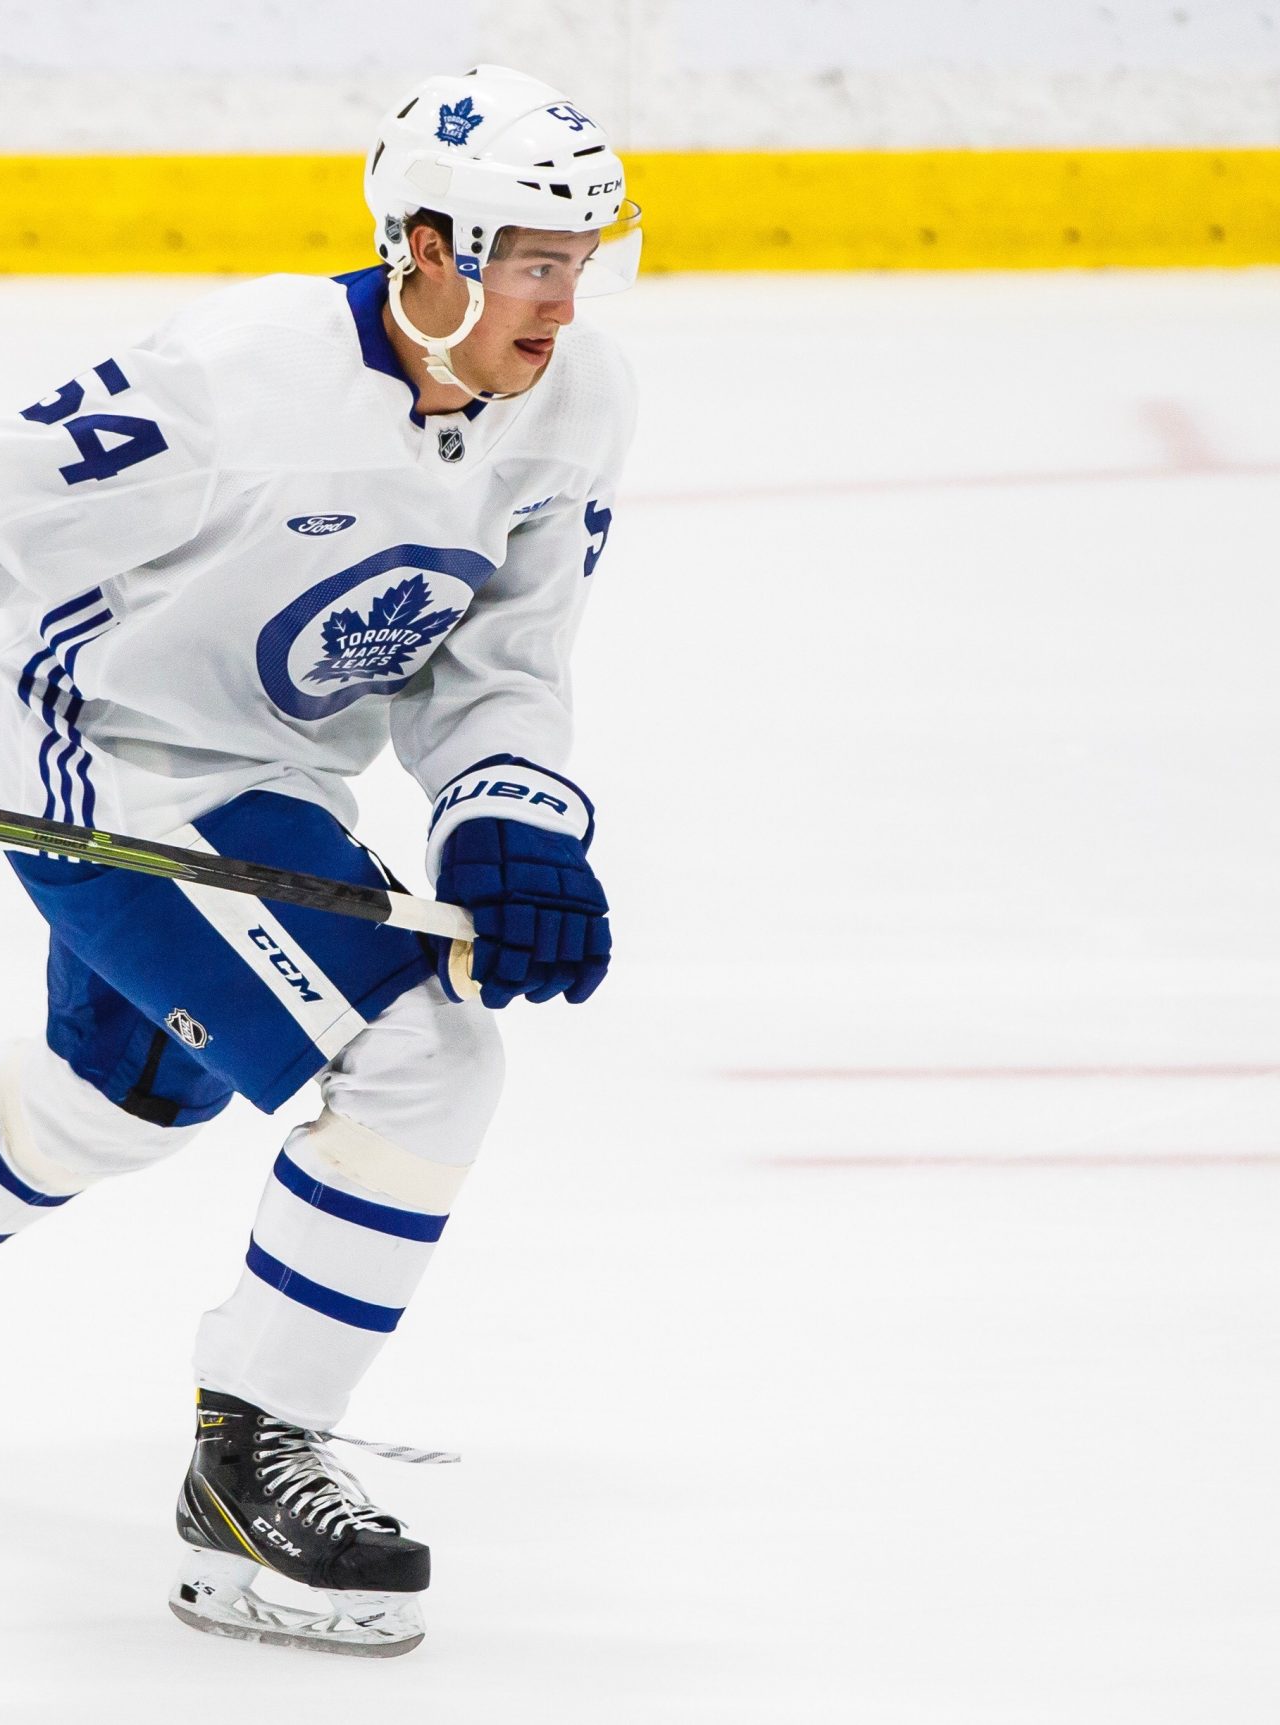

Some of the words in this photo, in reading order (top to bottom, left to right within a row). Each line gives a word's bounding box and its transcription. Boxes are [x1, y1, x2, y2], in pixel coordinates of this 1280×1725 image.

[546, 105, 597, 132] 54
[298, 516, 347, 533] Ford
[336, 628, 422, 650] TORONTO
[331, 656, 392, 669] LEAFS
[341, 644, 402, 659] MAPLE
[247, 924, 324, 1003] CCM
[252, 1515, 303, 1558] CCM
